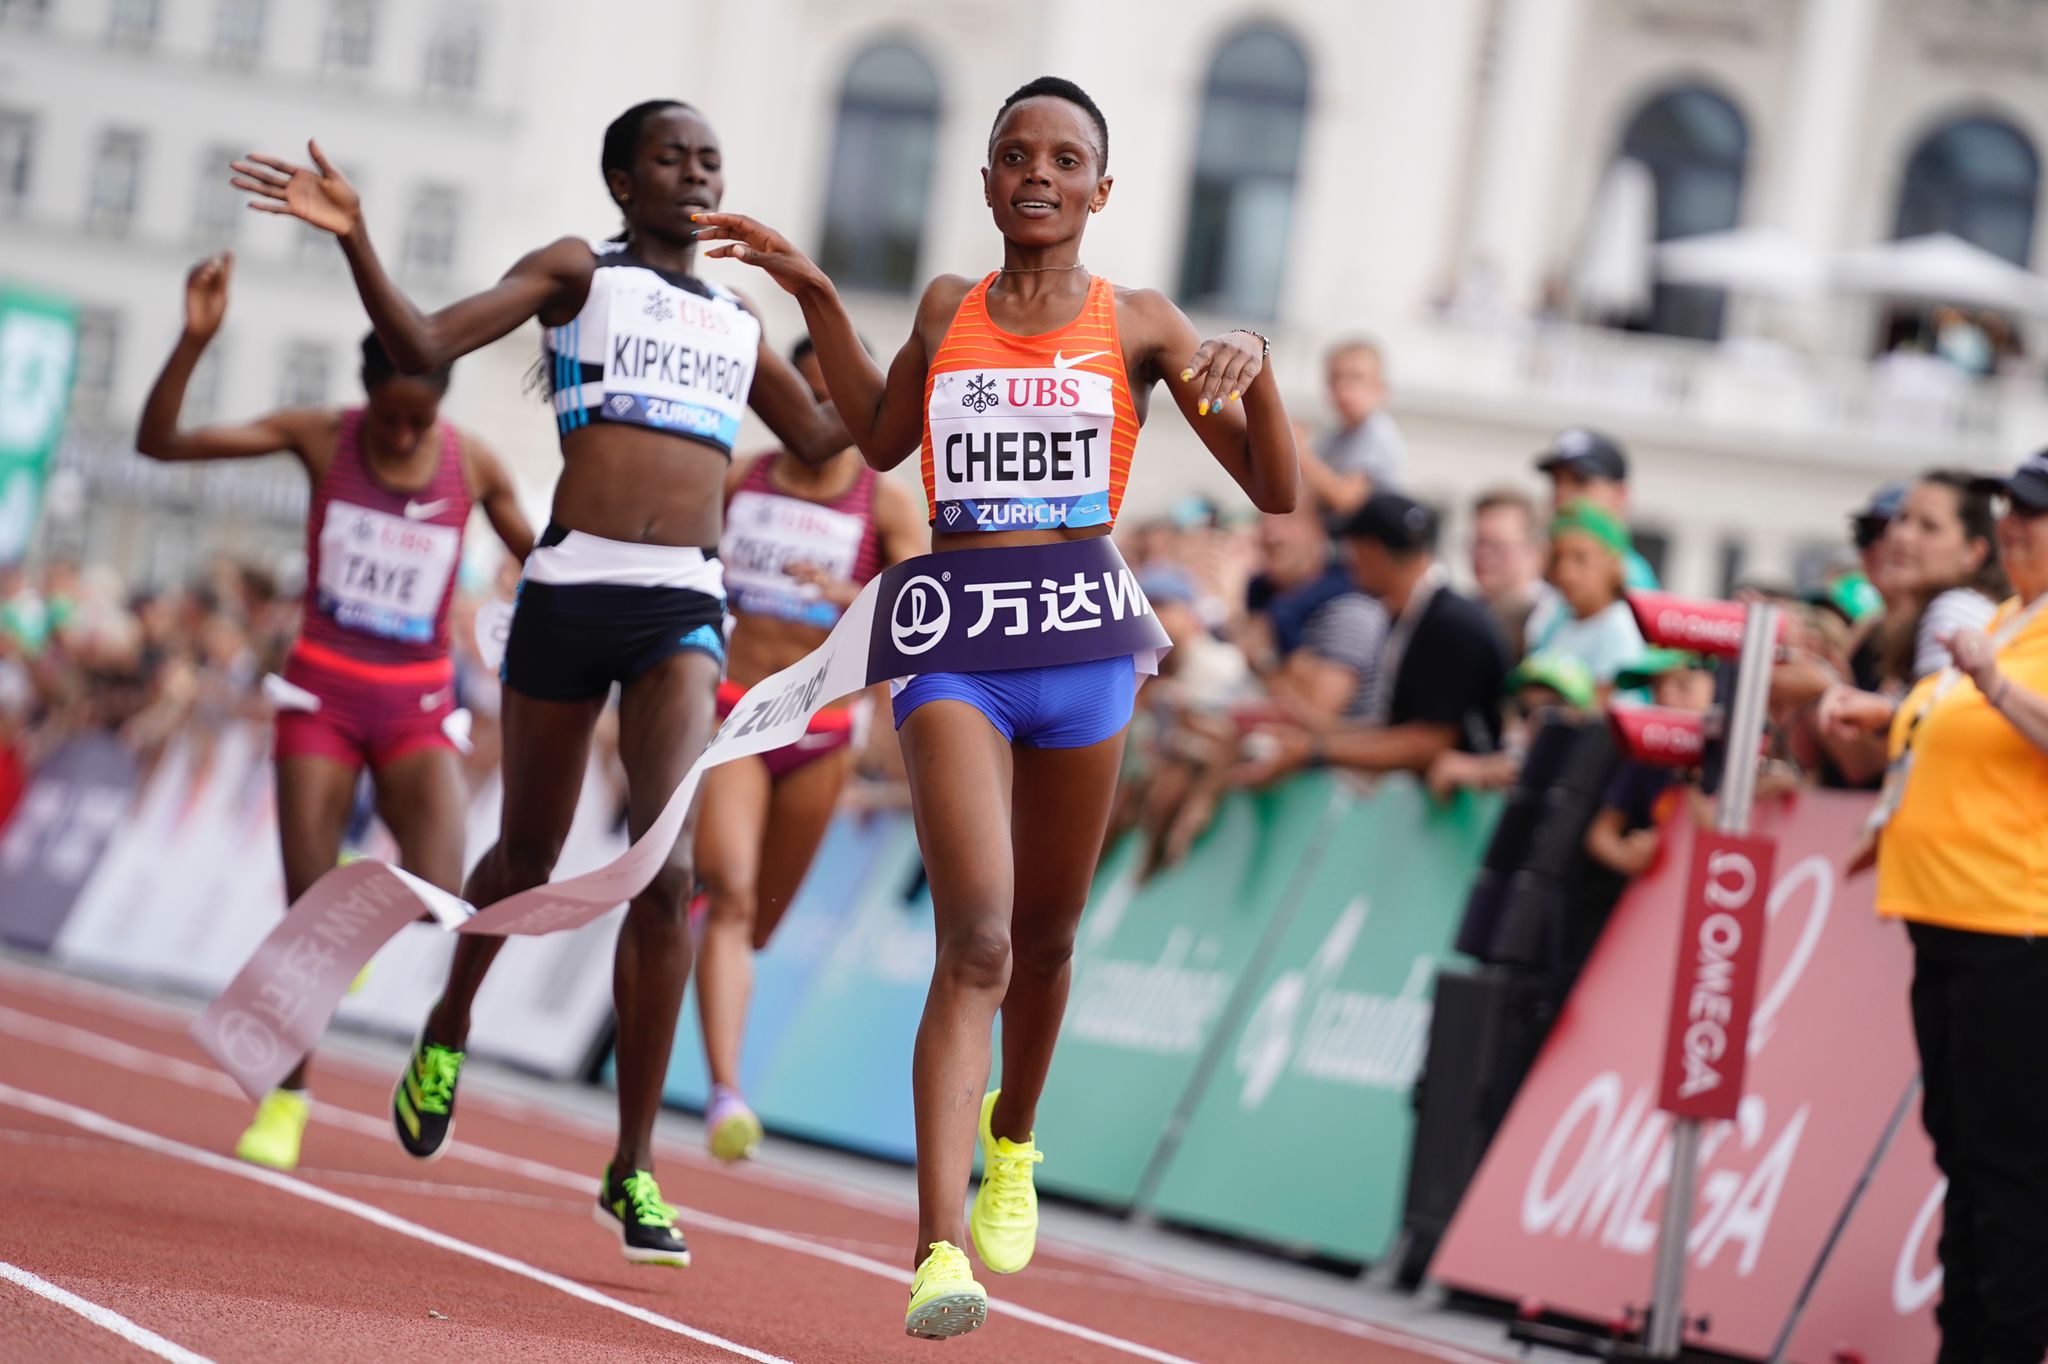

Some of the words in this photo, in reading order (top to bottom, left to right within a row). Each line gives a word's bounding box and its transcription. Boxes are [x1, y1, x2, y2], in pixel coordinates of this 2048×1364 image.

[1006, 378, 1080, 408] UBS
[945, 428, 1099, 483] CHEBET
[976, 503, 1067, 525] ZURICH
[345, 553, 420, 602] TAYE
[963, 572, 1102, 639] 万达
[1677, 912, 1743, 1099] OMEGA
